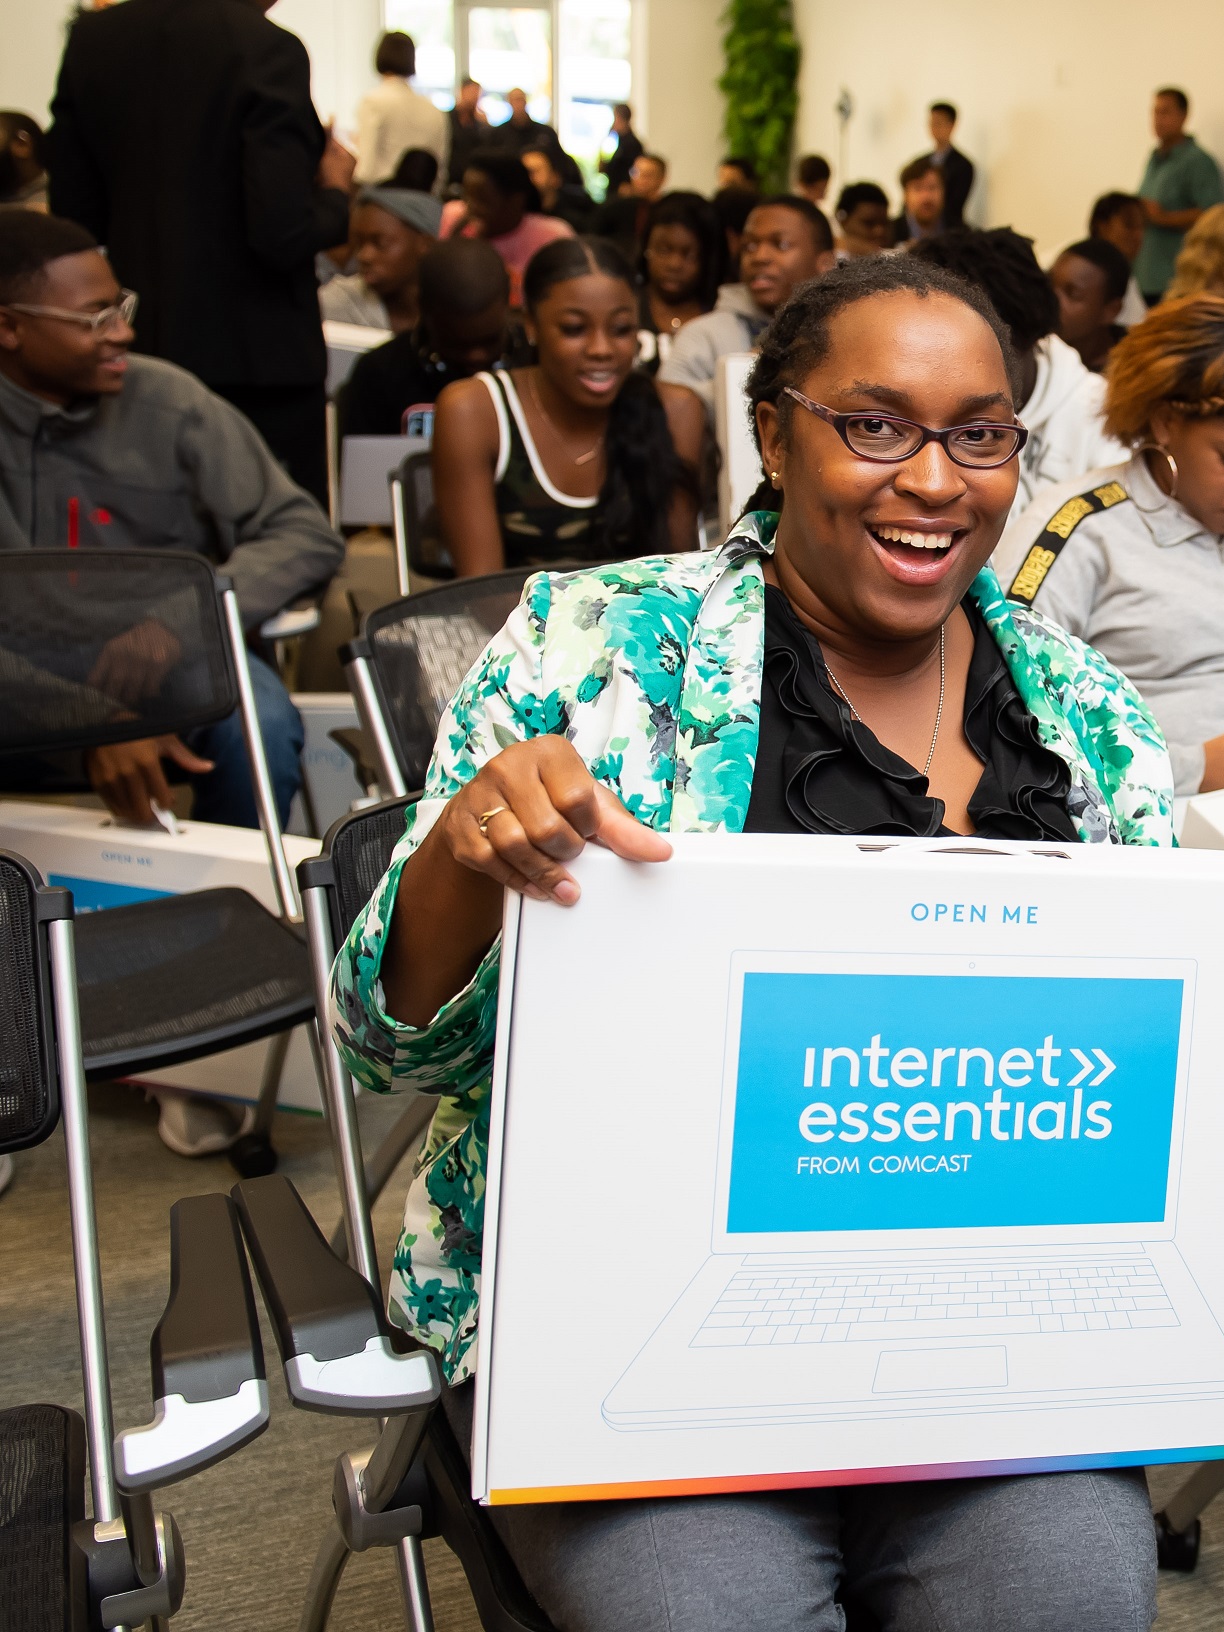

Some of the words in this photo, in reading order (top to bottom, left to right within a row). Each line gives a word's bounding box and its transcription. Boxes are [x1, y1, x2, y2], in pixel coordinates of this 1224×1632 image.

[910, 902, 987, 923] OPEN
[1001, 904, 1039, 925] ME
[803, 1033, 1062, 1088] internet
[798, 1088, 1113, 1143] essentials
[796, 1155, 860, 1175] FROM
[868, 1154, 972, 1174] COMCAST
